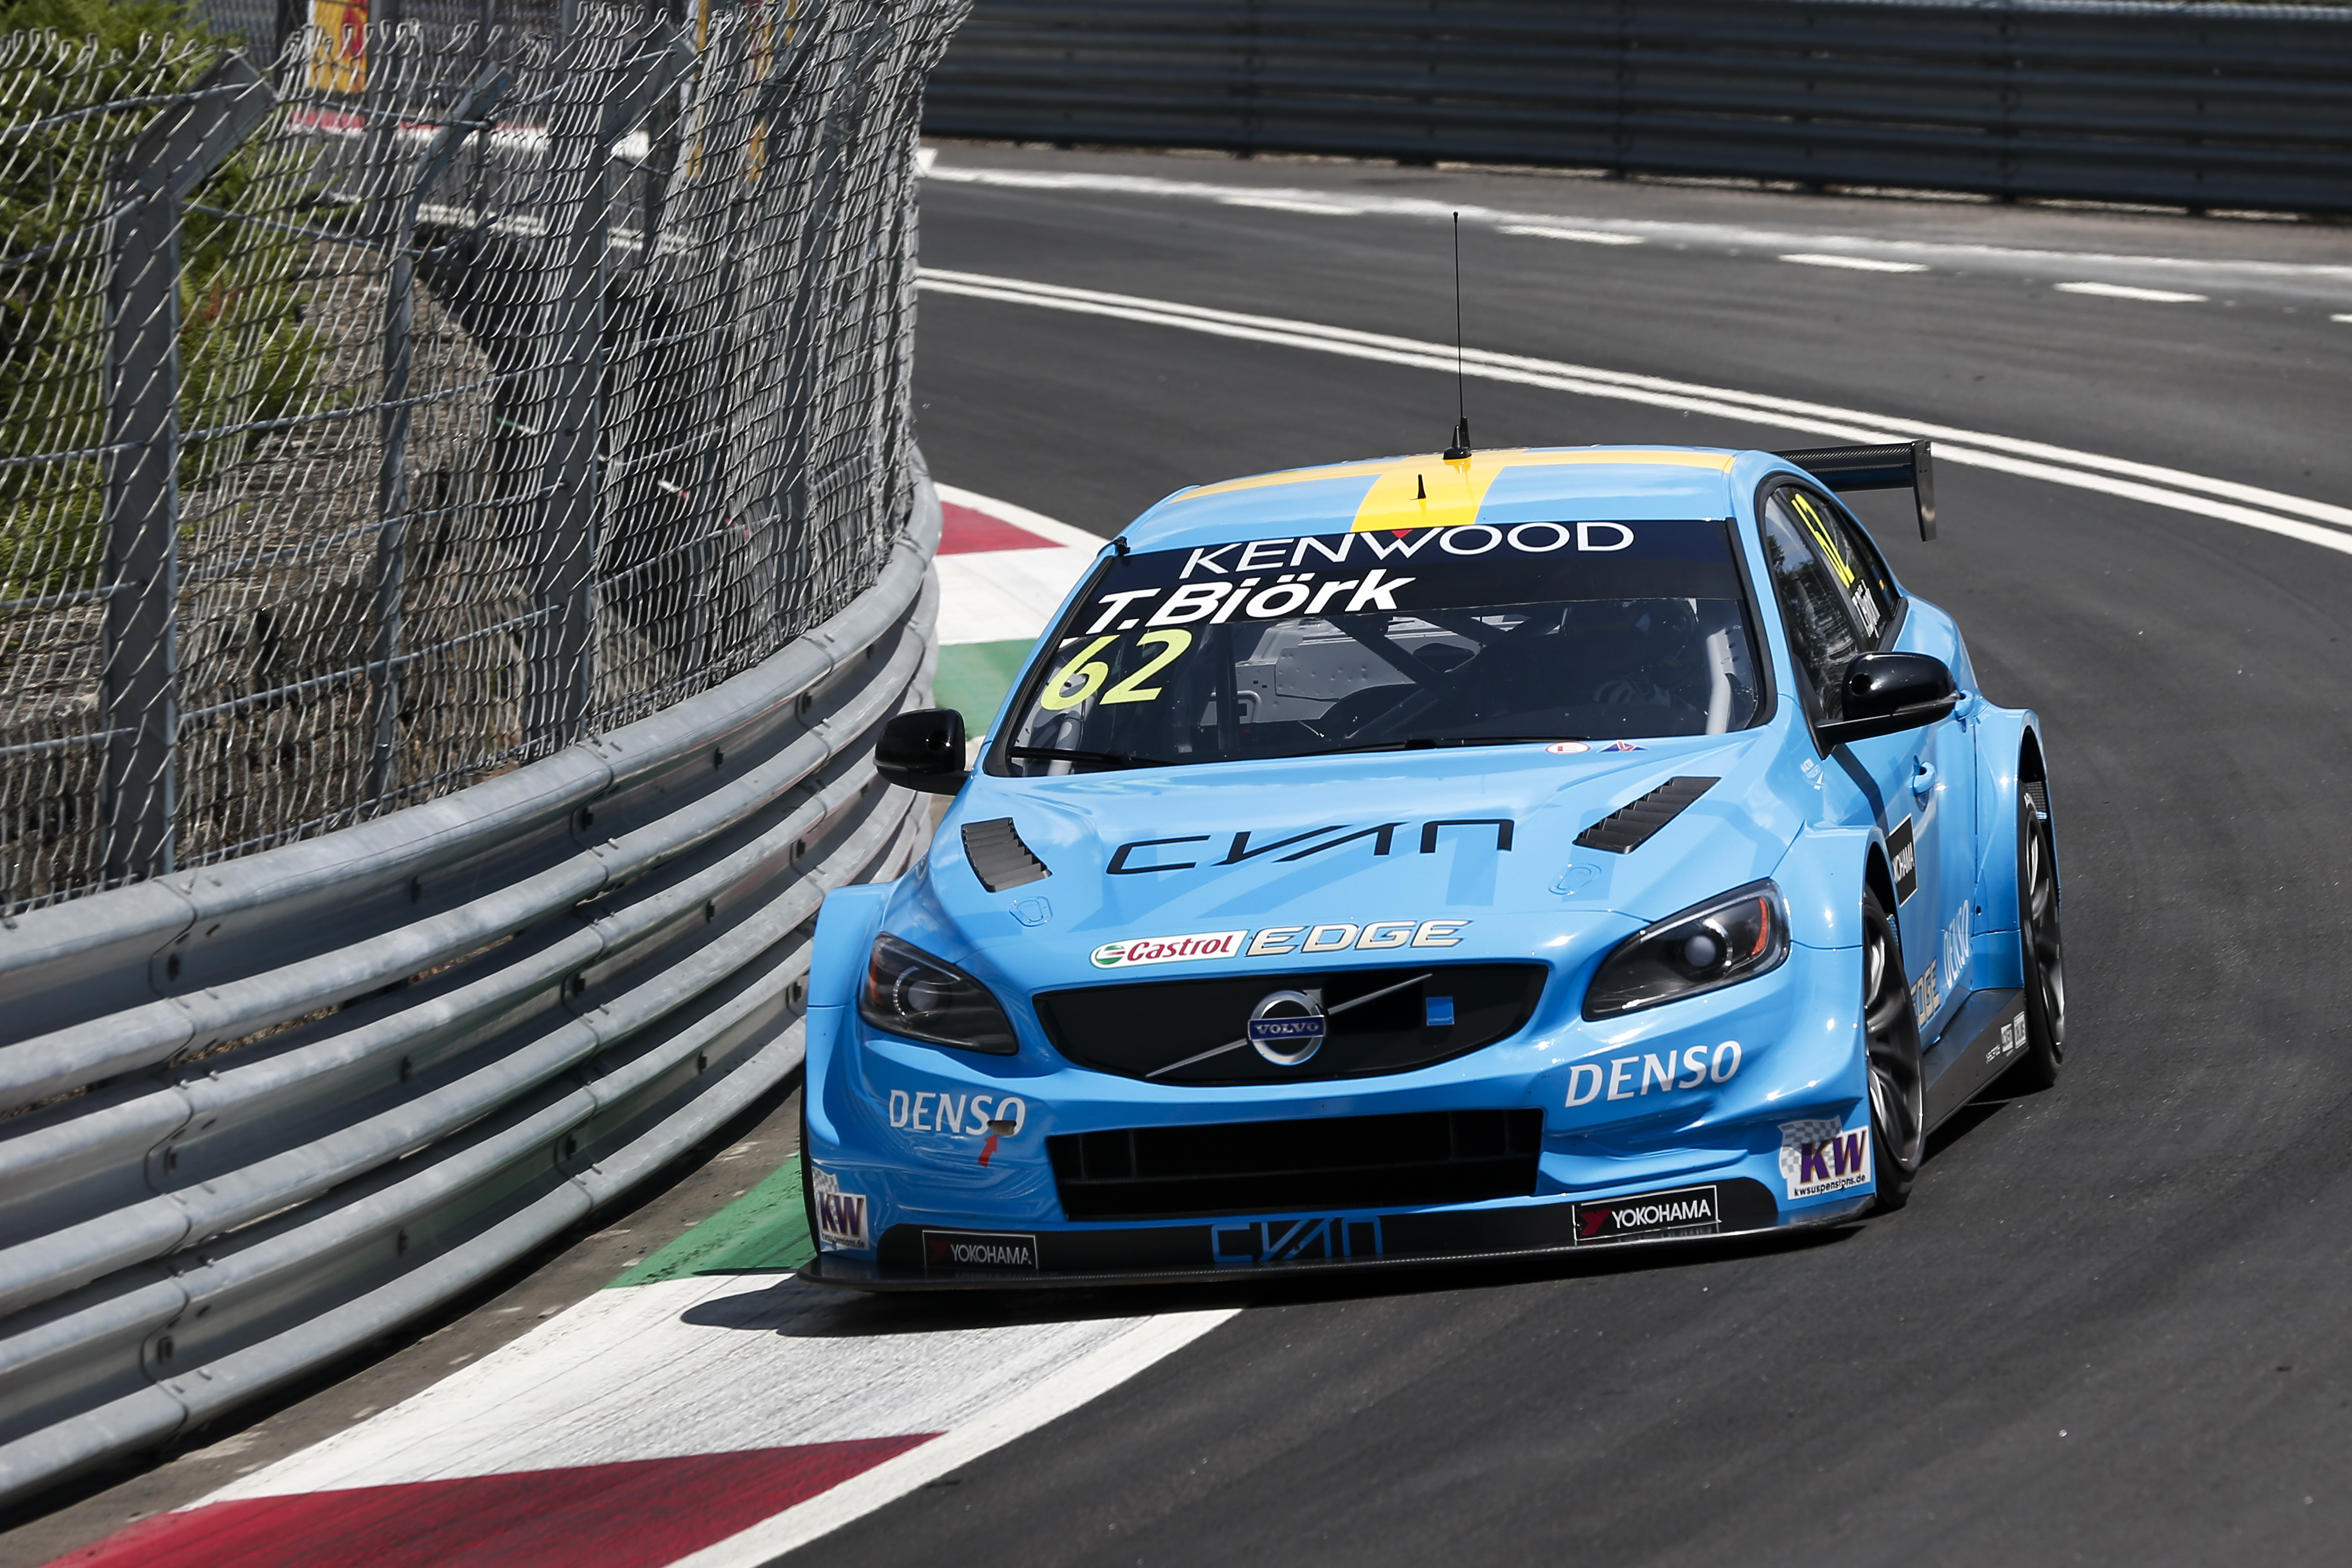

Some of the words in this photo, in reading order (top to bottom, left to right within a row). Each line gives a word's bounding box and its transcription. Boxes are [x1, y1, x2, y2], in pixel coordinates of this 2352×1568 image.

[1179, 522, 1634, 579] KENWOOD
[1085, 569, 1416, 635] T.Björk
[1041, 629, 1193, 710] 62
[1127, 935, 1233, 962] Castrol
[1245, 920, 1473, 957] EDGE
[1255, 1022, 1319, 1034] VOLVO
[1565, 1041, 1742, 1108] DENSO
[890, 1089, 1025, 1137] DENSO
[1801, 1130, 1867, 1185] KW
[819, 1192, 864, 1238] KW
[1612, 1200, 1712, 1229] YOKOHAMA
[950, 1244, 1032, 1265] YOKOHAMA
